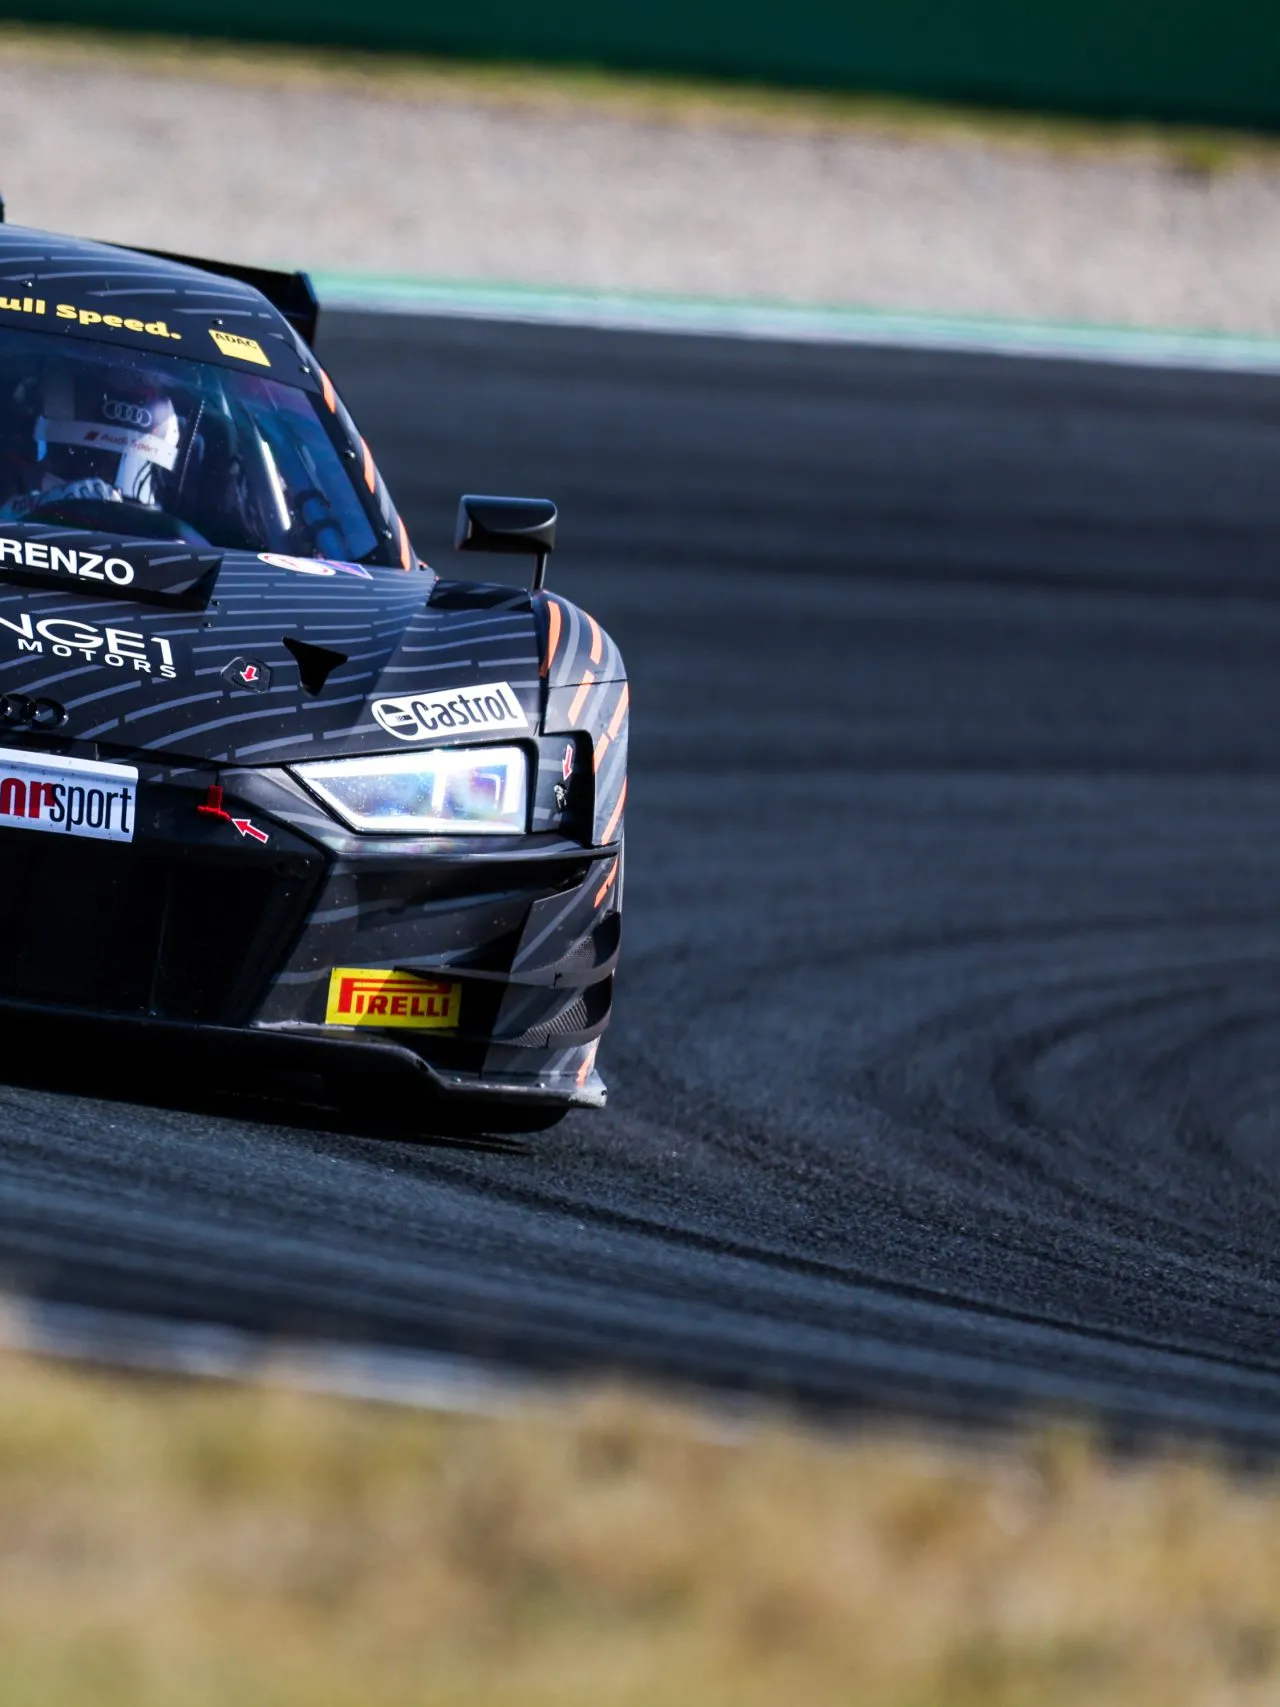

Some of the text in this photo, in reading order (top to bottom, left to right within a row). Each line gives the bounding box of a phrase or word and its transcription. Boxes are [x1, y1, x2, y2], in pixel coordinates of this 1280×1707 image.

[56, 303, 183, 340] Speed.
[215, 331, 259, 350] ADAC
[17, 637, 178, 680] MOTORS
[410, 688, 519, 731] Castrol
[337, 977, 454, 1018] PIRELLI
